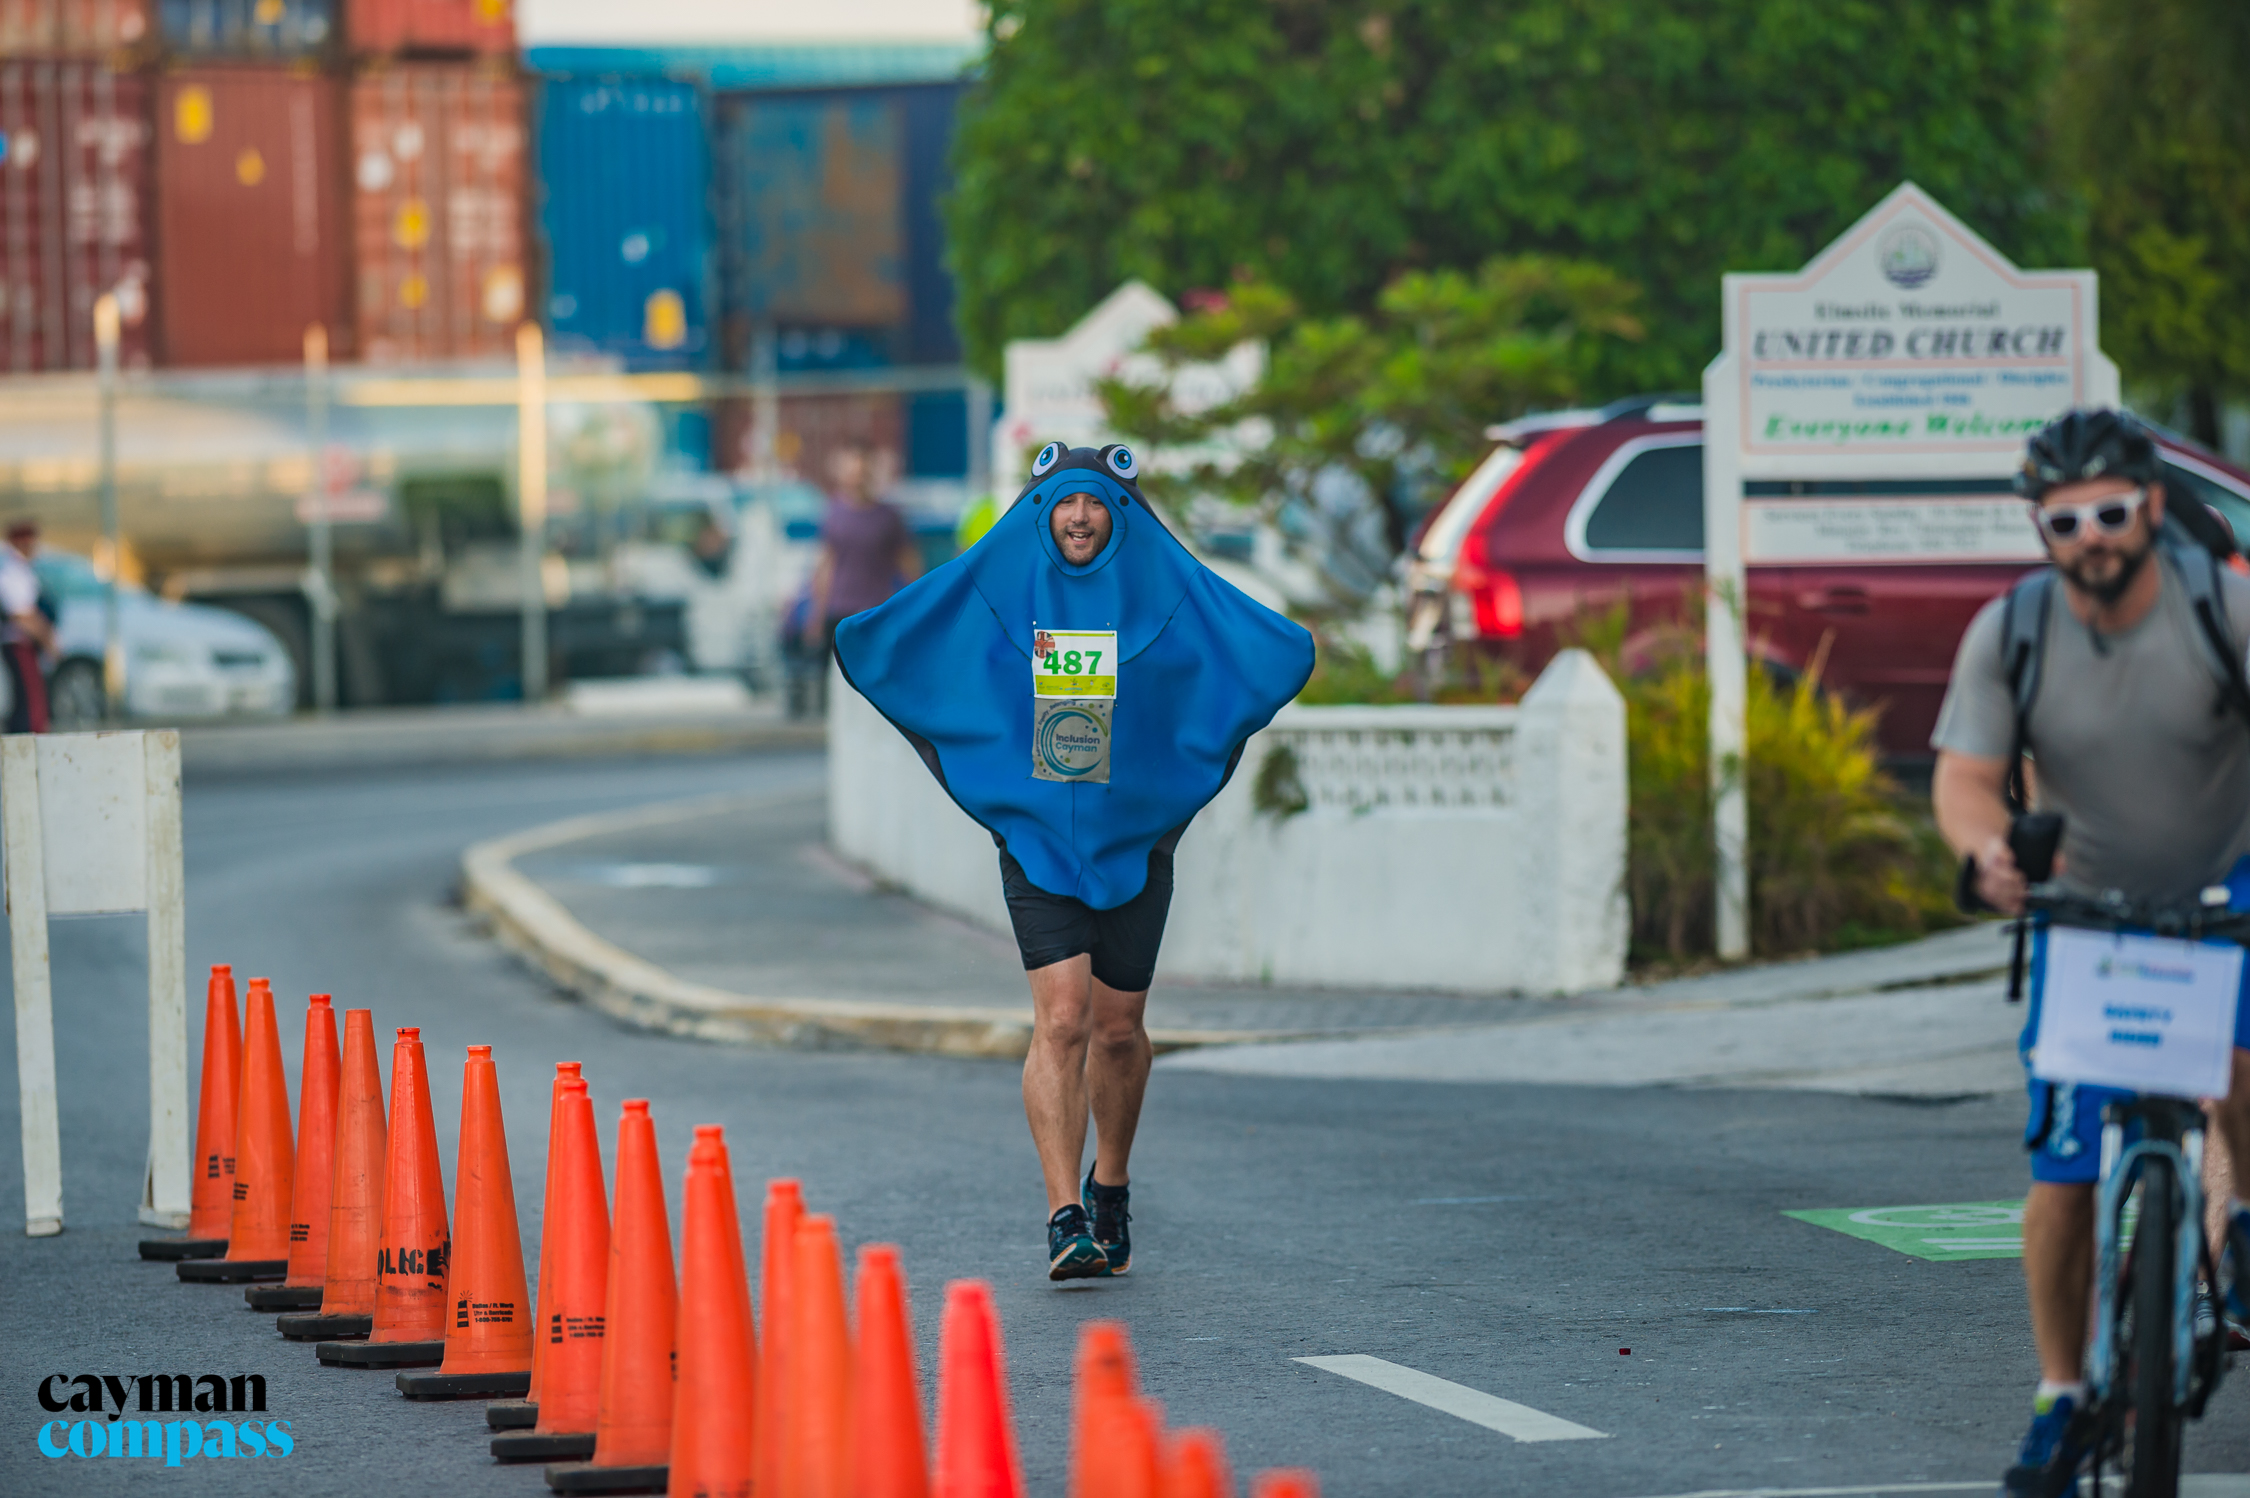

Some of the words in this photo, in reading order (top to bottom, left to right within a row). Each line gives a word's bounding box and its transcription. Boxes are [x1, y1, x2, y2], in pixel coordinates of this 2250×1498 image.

[1754, 329, 1895, 361] UNITED
[1905, 326, 2065, 359] CHURCH
[1763, 414, 1910, 444] Everyone
[1043, 650, 1103, 675] 487
[1055, 733, 1100, 745] Inclusion
[1055, 742, 1098, 753] Cayman
